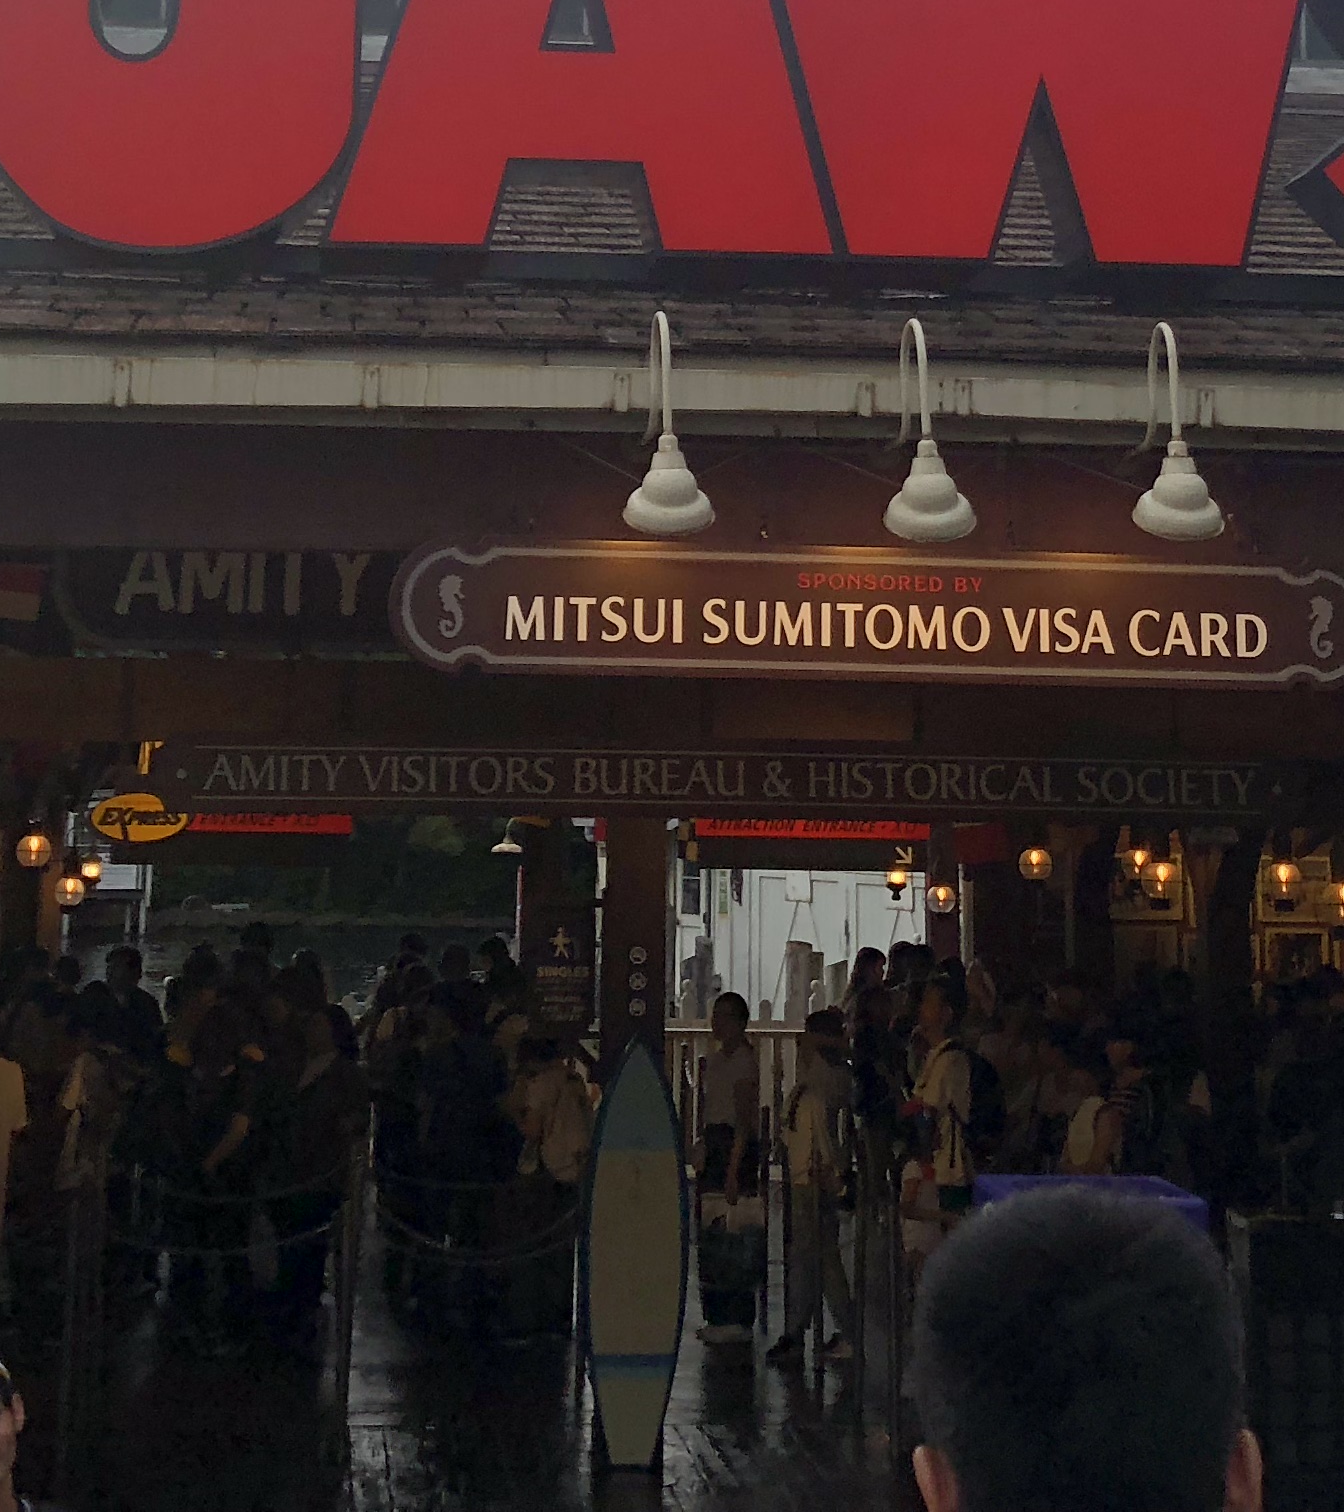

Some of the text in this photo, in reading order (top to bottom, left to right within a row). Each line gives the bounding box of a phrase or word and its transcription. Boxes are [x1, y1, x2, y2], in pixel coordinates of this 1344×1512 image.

[113, 551, 370, 616] AMITY
[797, 572, 983, 593] SPONSORED BY
[505, 595, 1268, 659] MITSUI SUMITOMO VISA CARD
[203, 753, 1255, 806] AMITY VISITORS BUREAU & HISTORICAL SOCIETY
[707, 818, 875, 832] ATTRACTION ENTRANCE
